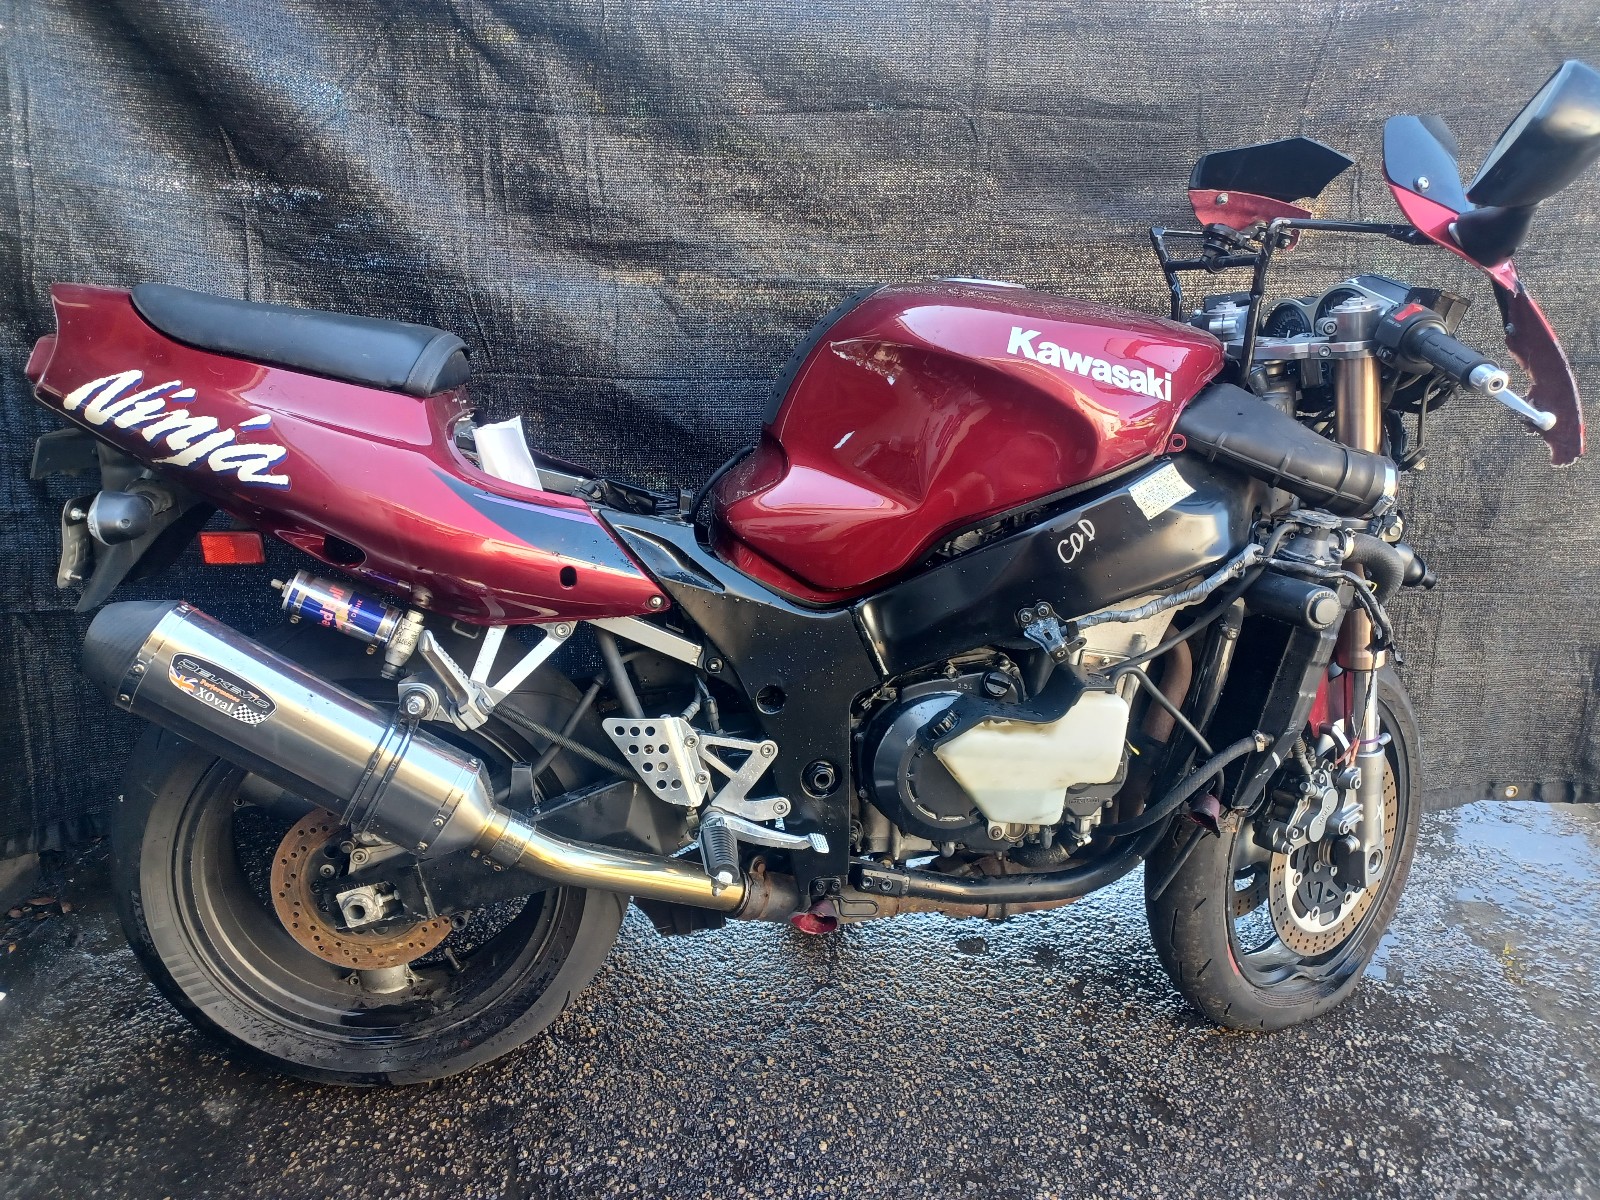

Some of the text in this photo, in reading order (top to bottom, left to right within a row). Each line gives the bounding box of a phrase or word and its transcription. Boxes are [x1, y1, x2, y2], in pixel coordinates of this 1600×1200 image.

[1006, 327, 1172, 401] Kawasaki
[63, 369, 291, 490] Ninja
[195, 686, 235, 713] XOval
[199, 678, 241, 703] Performance
